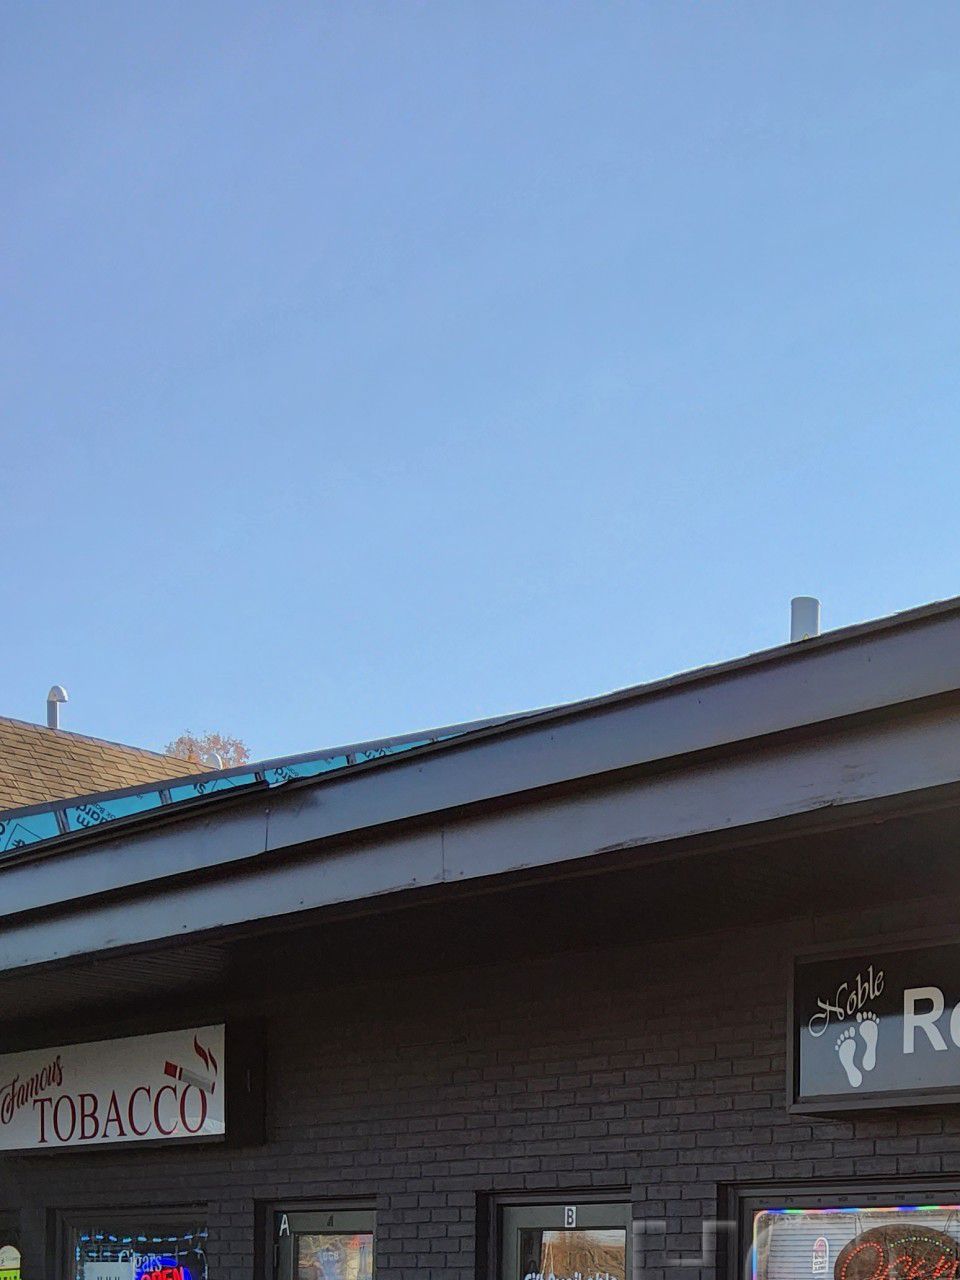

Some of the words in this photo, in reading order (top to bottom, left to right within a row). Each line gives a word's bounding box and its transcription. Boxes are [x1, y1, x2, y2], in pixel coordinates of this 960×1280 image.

[807, 965, 885, 1038] Noble
[1, 1055, 64, 1125] Famous
[33, 1085, 208, 1144] TOBACCO
[279, 1214, 290, 1237] A
[566, 1208, 575, 1226] B
